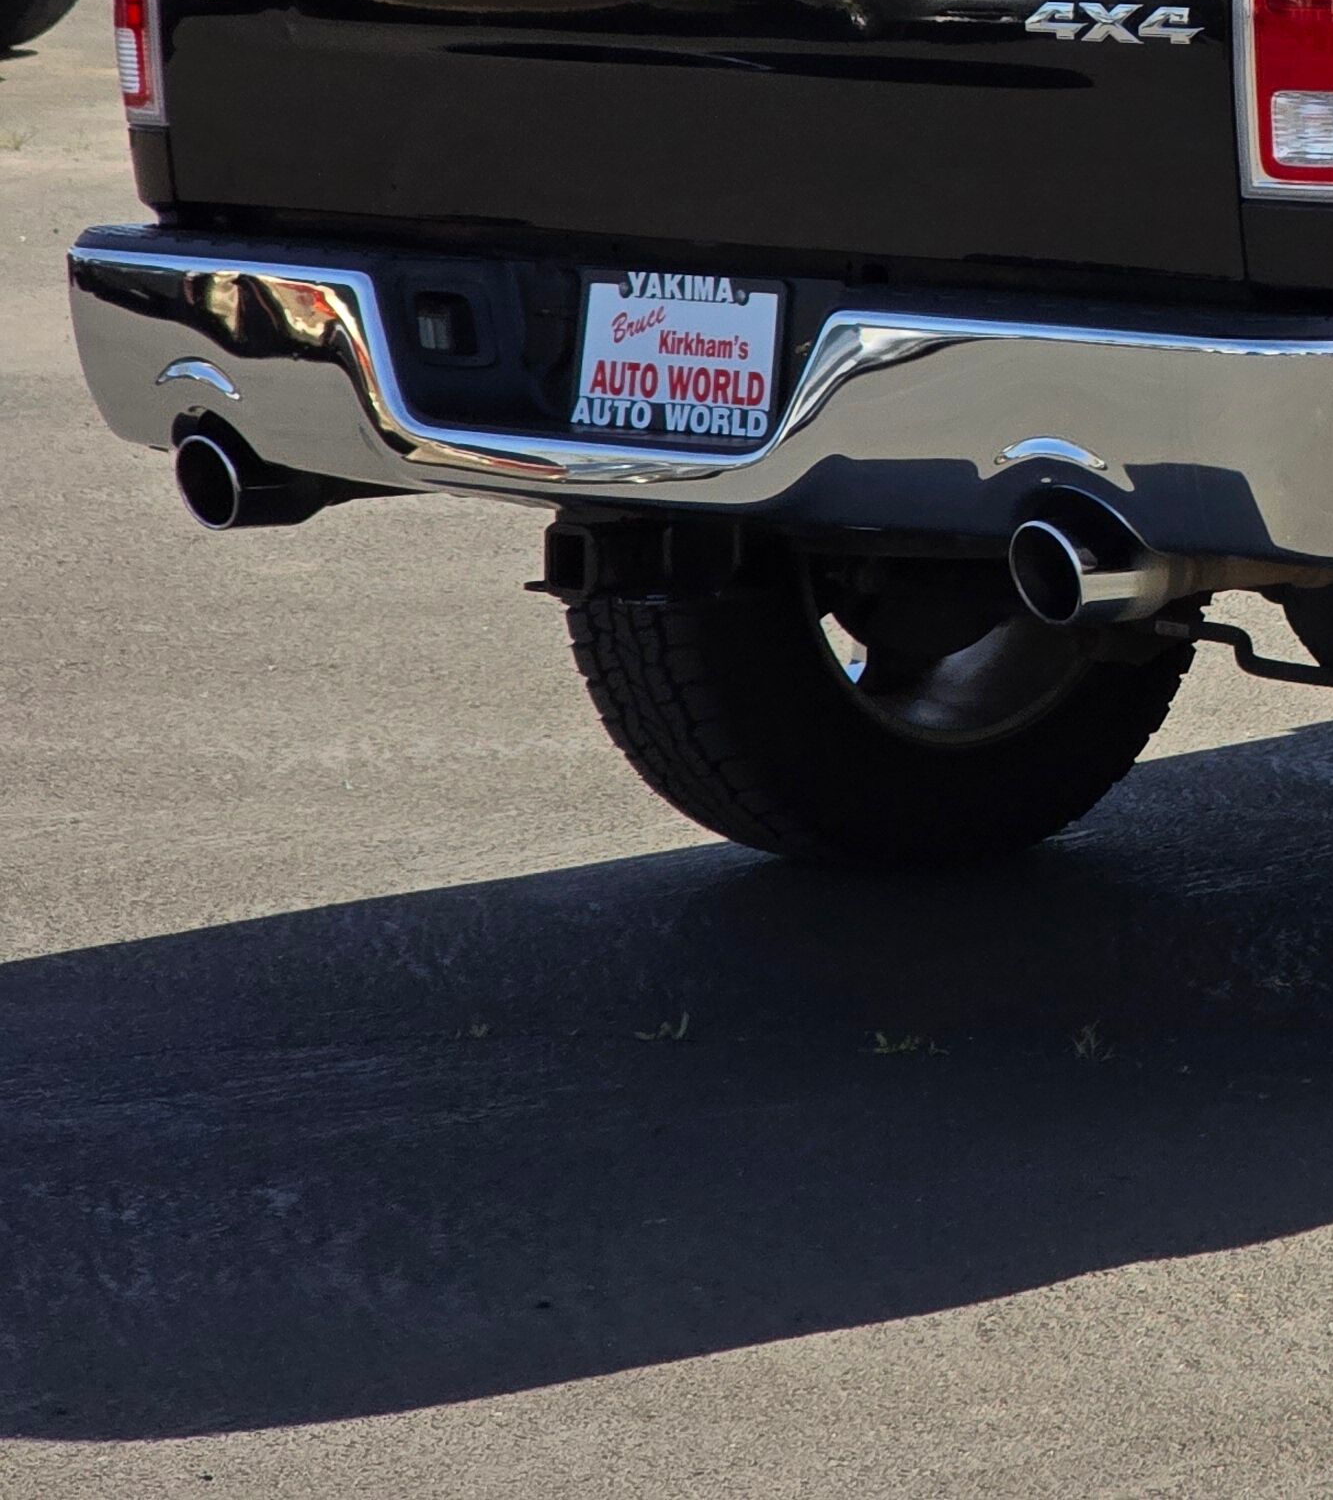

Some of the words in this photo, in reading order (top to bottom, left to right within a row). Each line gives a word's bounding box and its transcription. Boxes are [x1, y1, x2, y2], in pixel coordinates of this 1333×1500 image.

[1025, 1, 1205, 44] 4X4
[627, 272, 735, 303] YAKIMA
[612, 306, 666, 343] Bruce
[659, 330, 749, 360] Kirkham's
[589, 360, 658, 399] AUTO
[667, 365, 765, 406] WORLD
[571, 398, 652, 430] AUTO
[665, 403, 768, 437] WORLD
